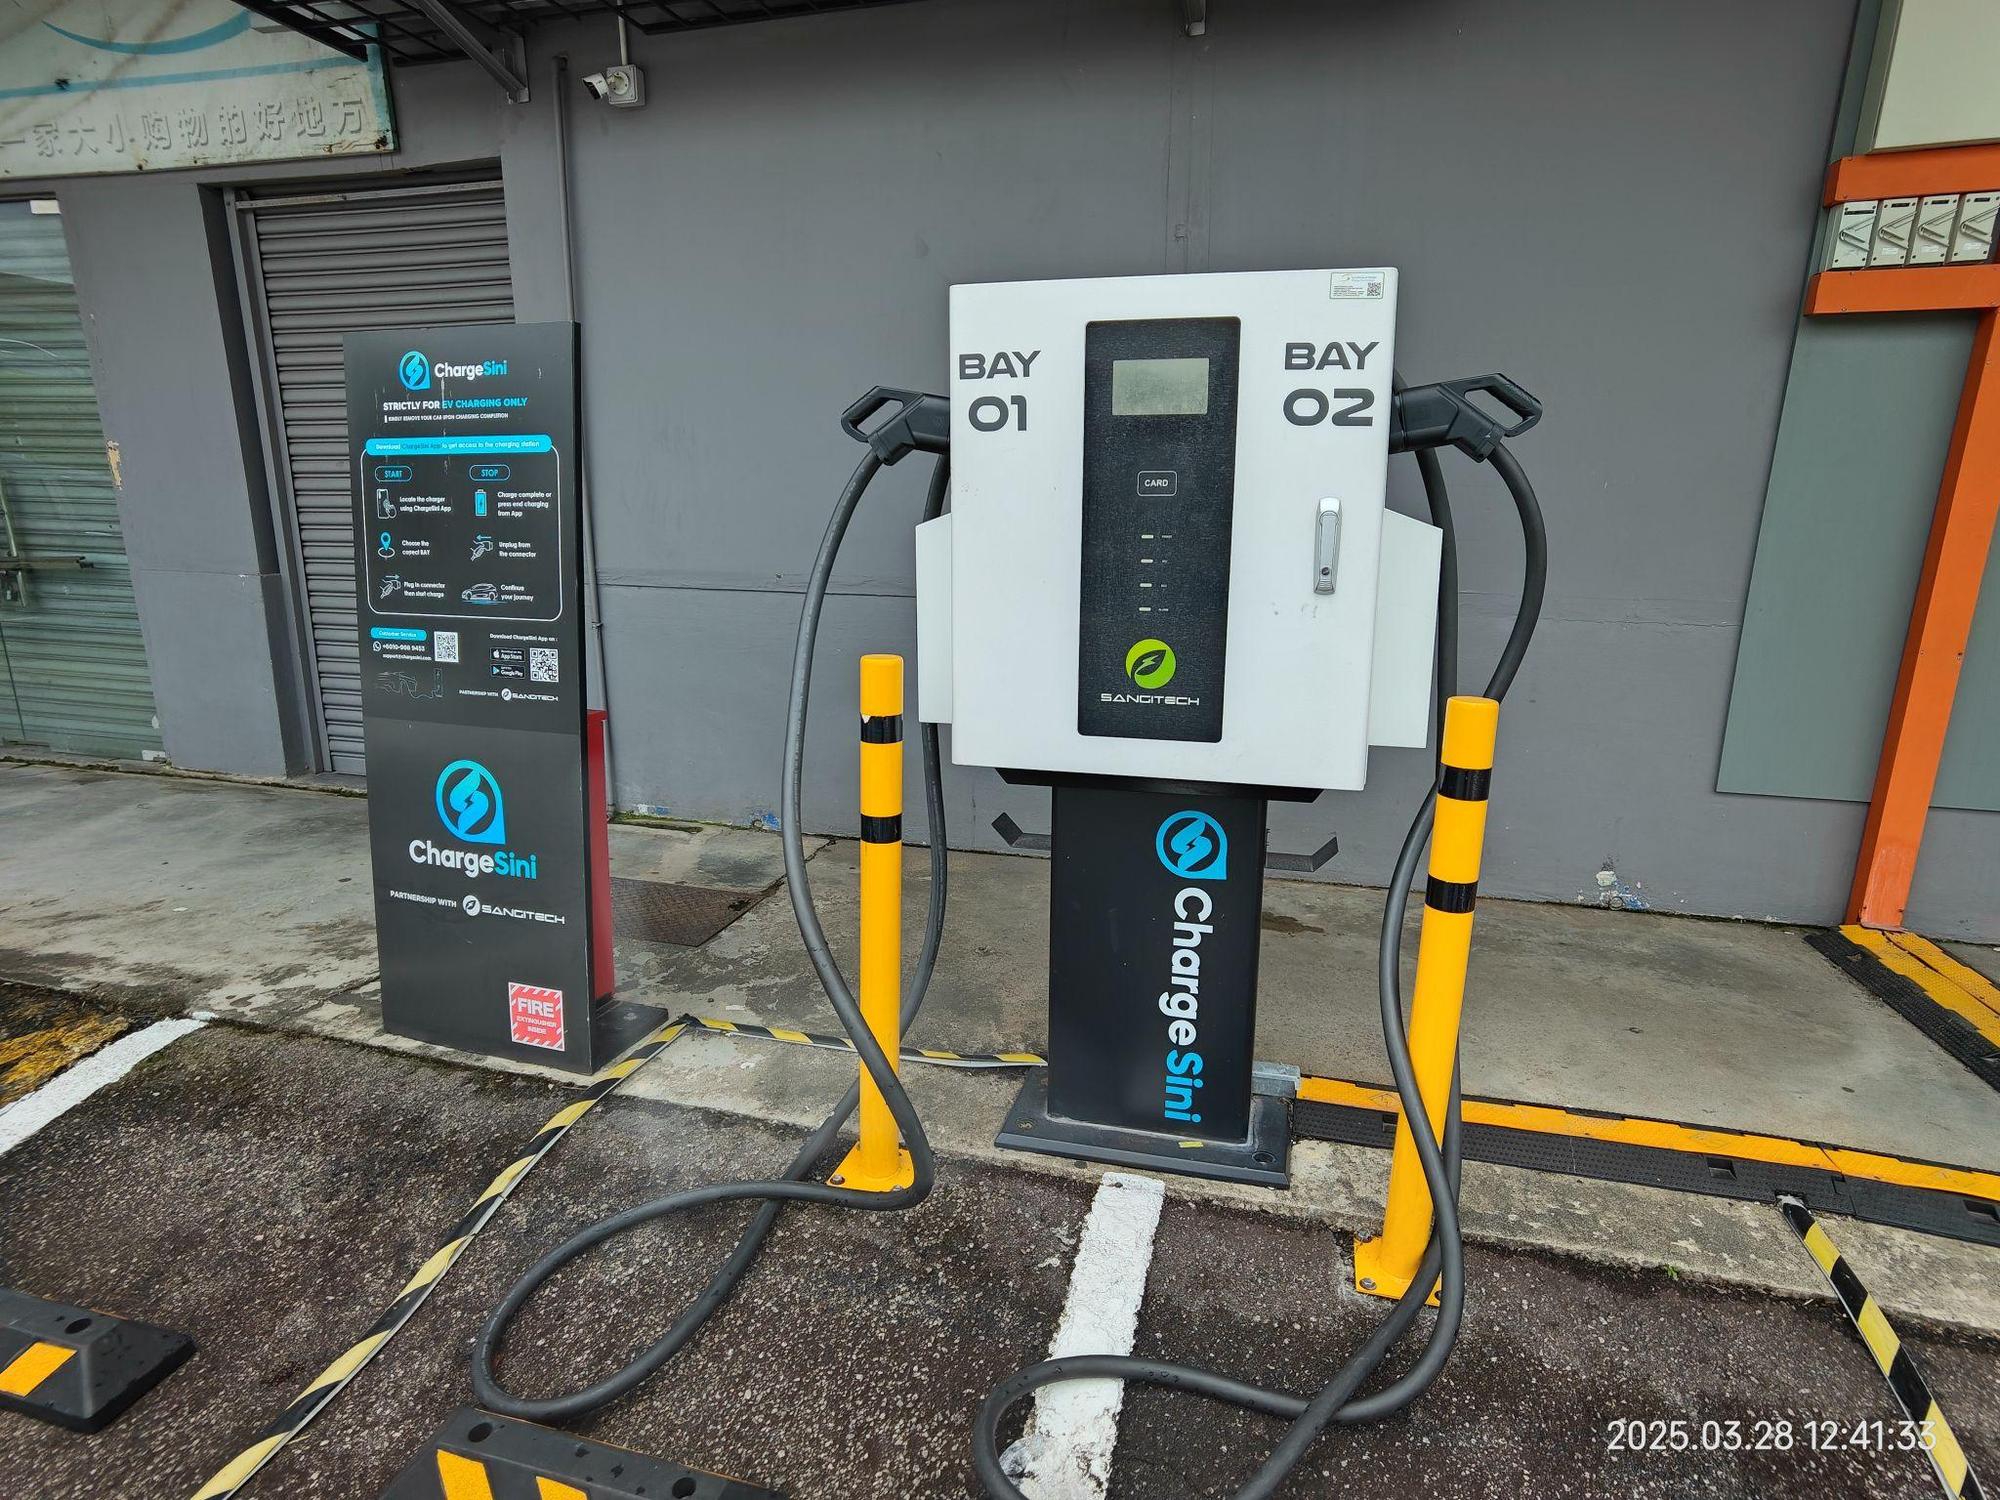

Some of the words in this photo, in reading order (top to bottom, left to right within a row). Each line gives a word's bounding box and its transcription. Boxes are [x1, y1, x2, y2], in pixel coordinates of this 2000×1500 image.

[1284, 342, 1380, 370] BAY
[434, 360, 508, 381] ChargeSini
[959, 350, 1041, 380] BAY
[383, 401, 422, 411] STRICTLY
[422, 401, 440, 410] FOR
[442, 400, 454, 409] EV
[455, 398, 501, 408] CHARGING
[503, 397, 528, 407] ONLY
[1283, 388, 1375, 427] 02
[968, 395, 1027, 432] 01
[494, 441, 520, 449] charging
[384, 470, 403, 478] START
[480, 469, 499, 477] STOP
[1144, 479, 1169, 487] CARD
[497, 491, 517, 499] Charge
[518, 491, 545, 499] complete
[524, 500, 549, 508] charging
[513, 594, 534, 602] journey
[512, 692, 559, 702] SANGITECH
[1100, 692, 1200, 706] SANGITECH
[408, 839, 537, 880] ChargeSini
[390, 890, 437, 904] PARTNERSHIP
[437, 898, 457, 908] WITH
[481, 904, 566, 925] SANGITECH
[517, 997, 555, 1018] FIRE
[1158, 887, 1214, 1123] ChargeSini
